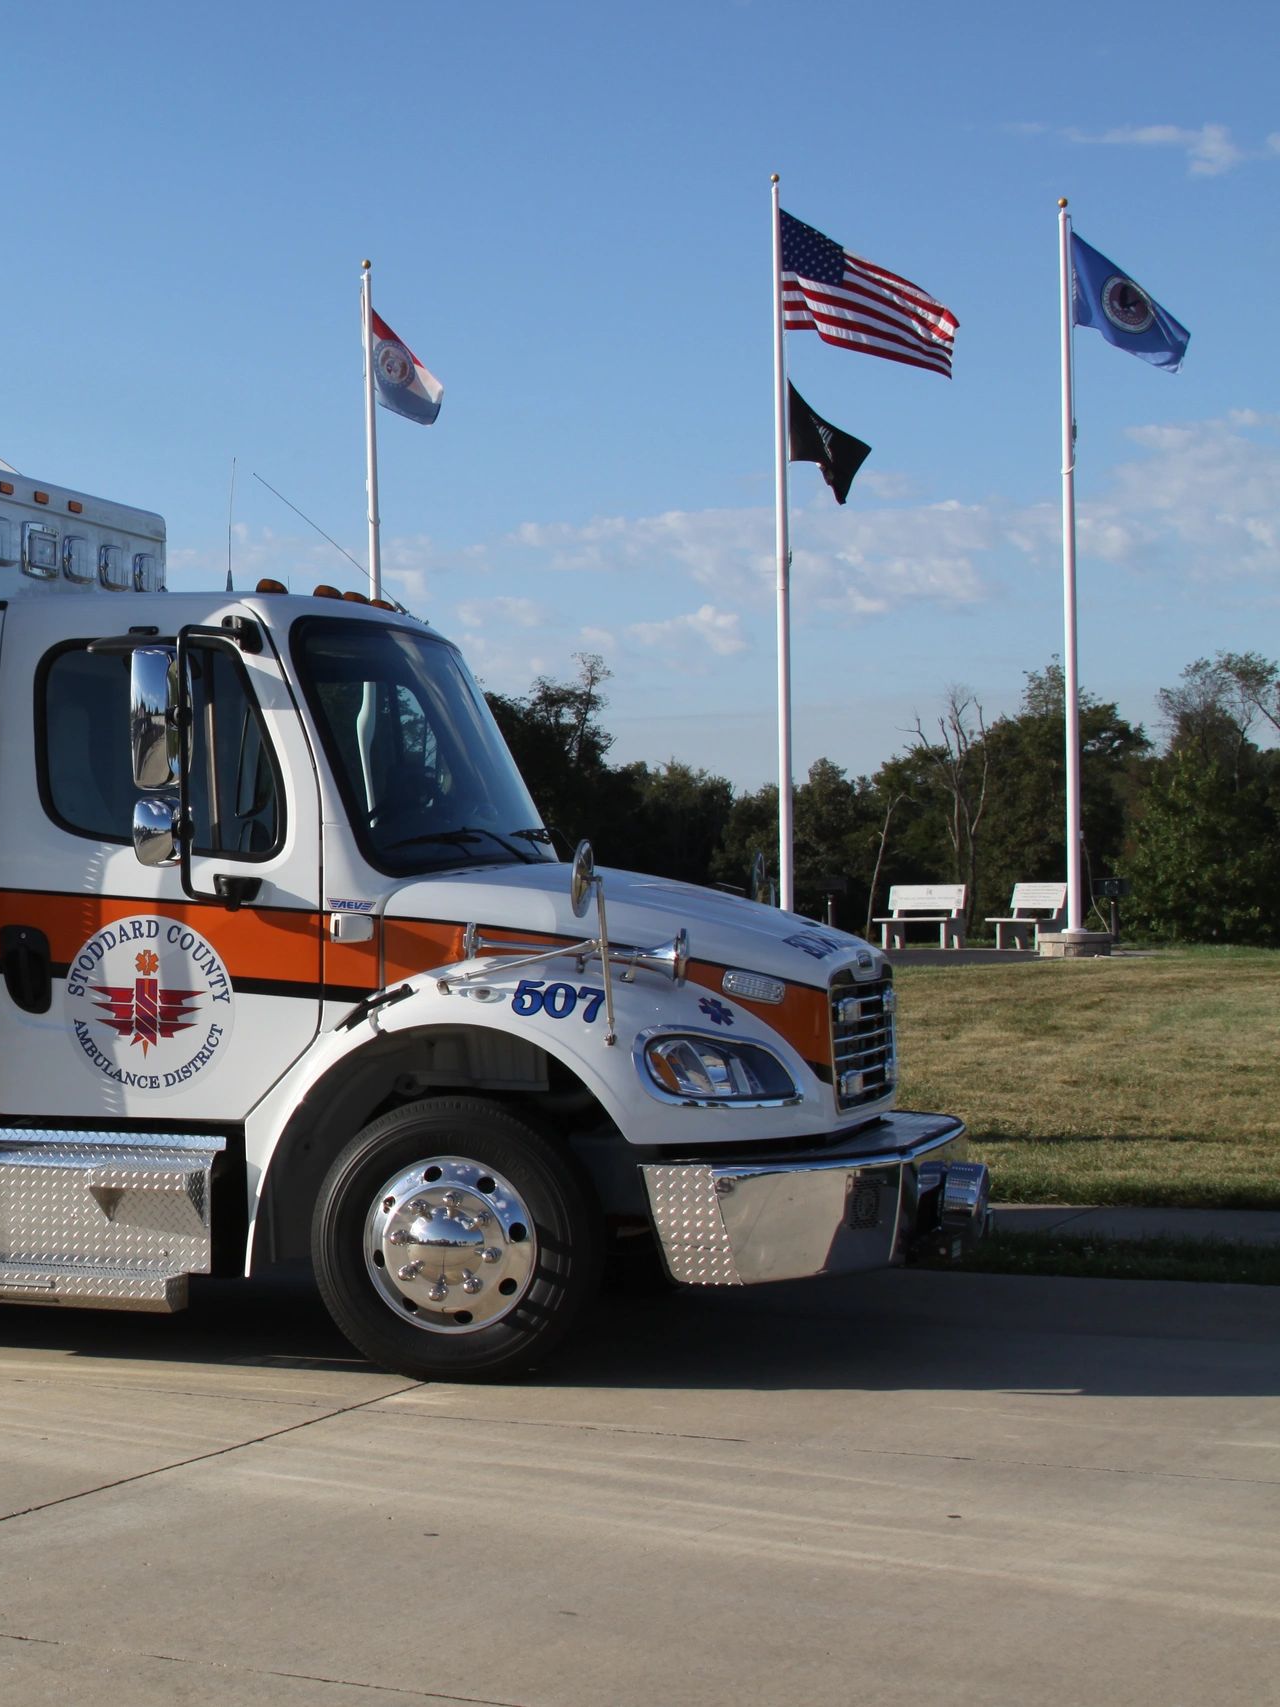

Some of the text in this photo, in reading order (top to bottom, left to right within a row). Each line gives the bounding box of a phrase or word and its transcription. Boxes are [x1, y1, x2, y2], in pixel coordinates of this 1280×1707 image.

[67, 919, 231, 1004] STODDARD COUNTY
[511, 979, 606, 1024] 507
[73, 1018, 224, 1089] AMBULANCE DISTRICT
